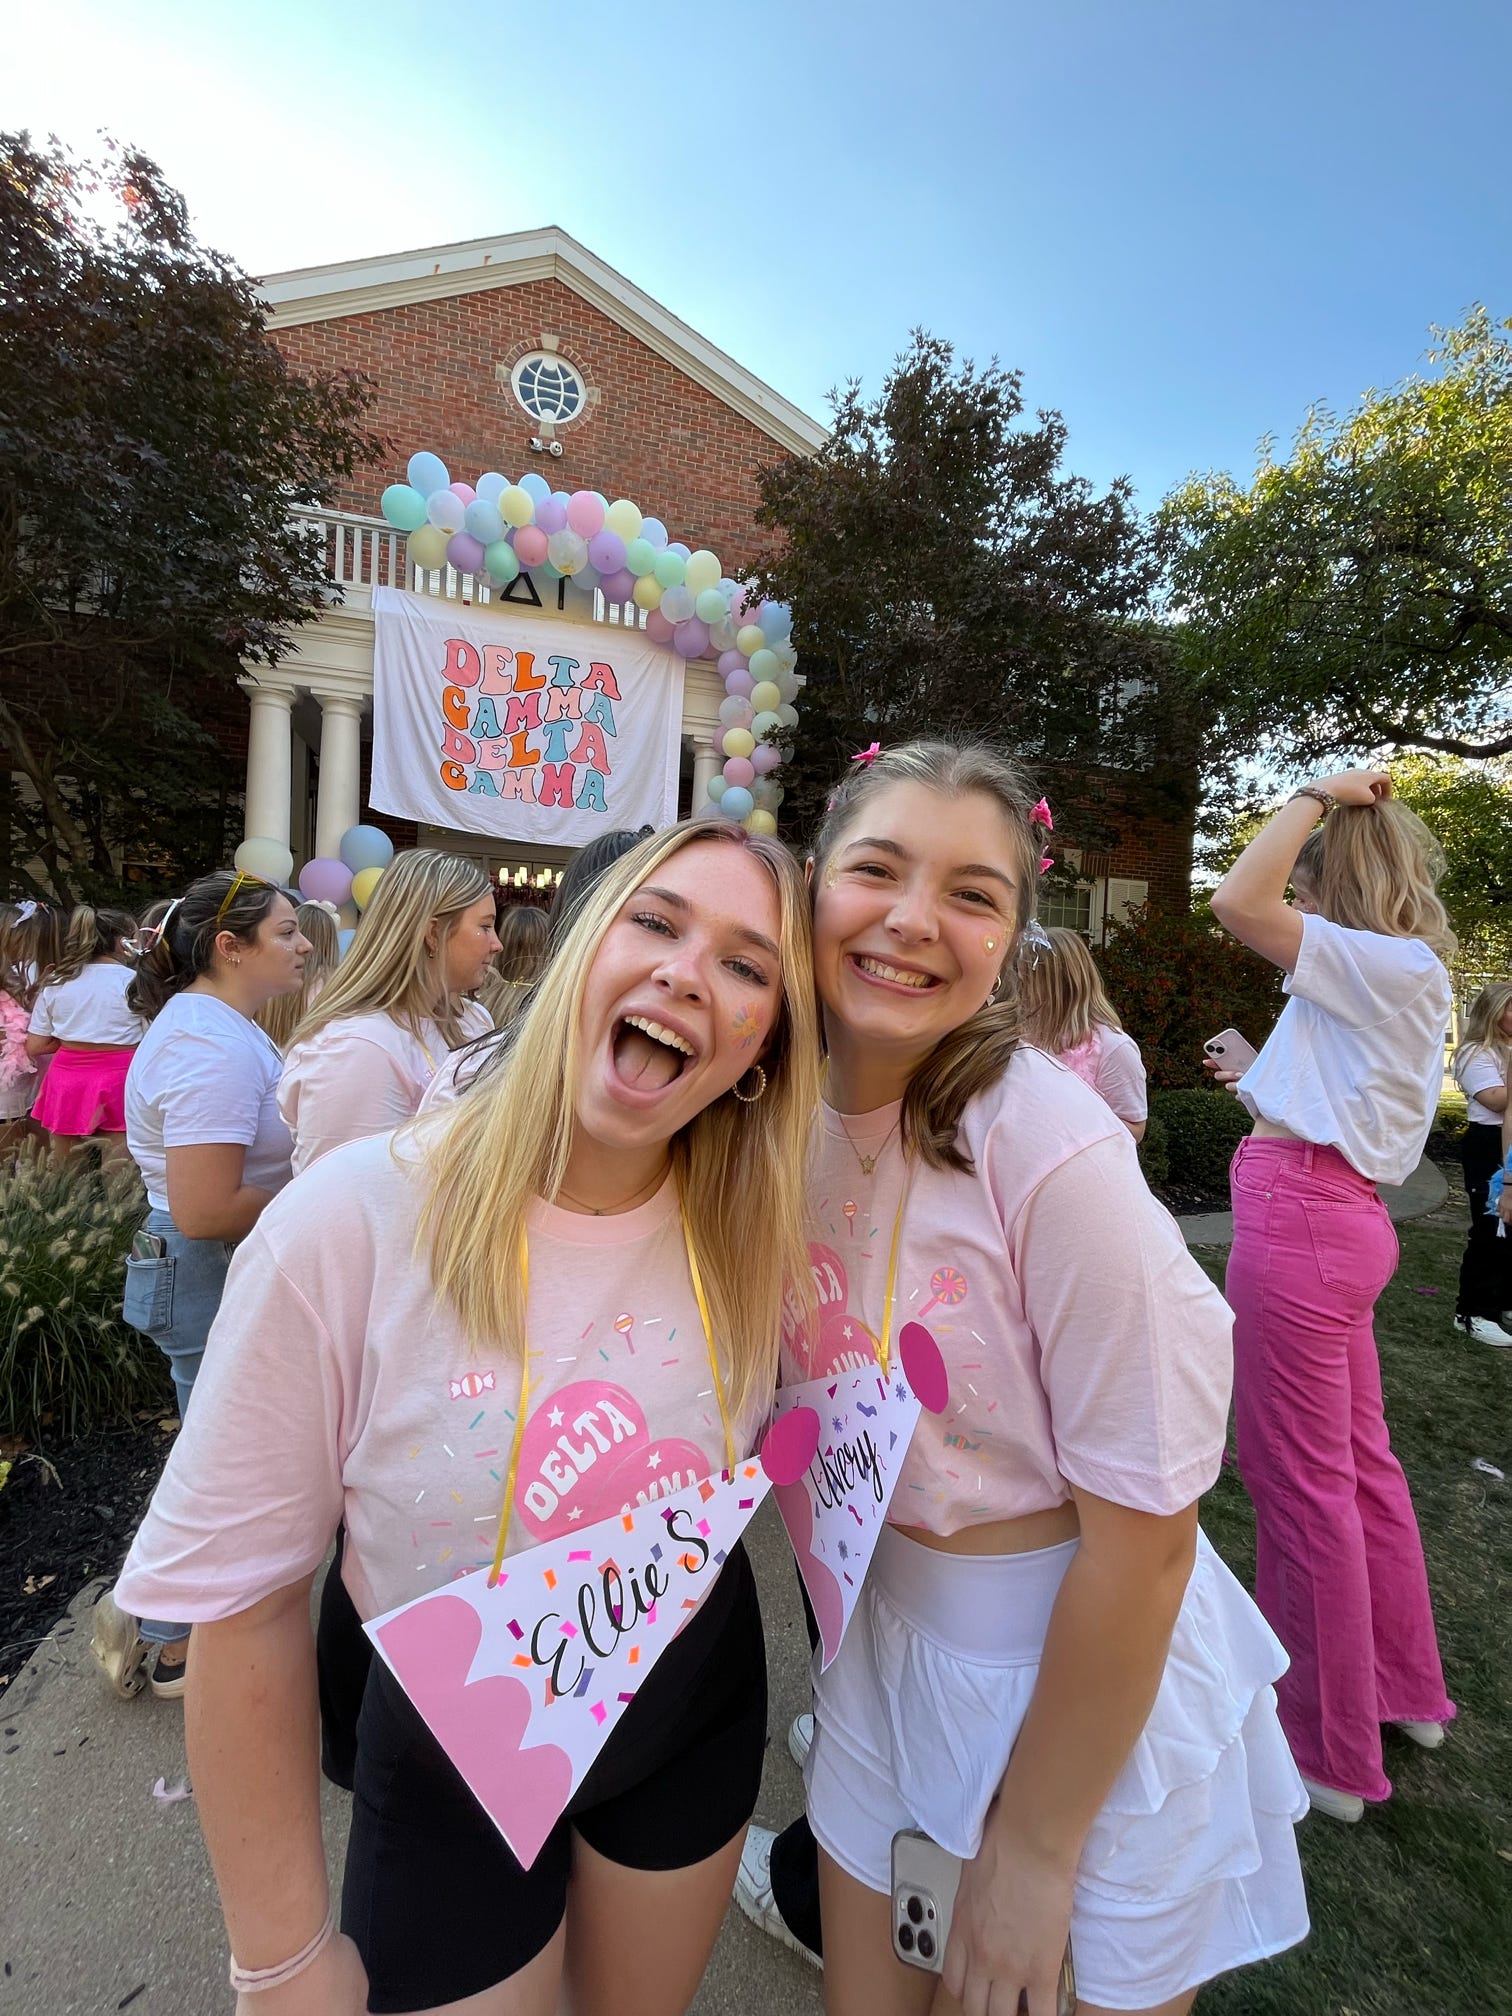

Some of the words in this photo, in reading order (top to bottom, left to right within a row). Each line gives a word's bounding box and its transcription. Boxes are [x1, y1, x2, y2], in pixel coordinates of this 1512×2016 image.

[441, 638, 622, 701] DELTA
[442, 685, 617, 738] GAMMA
[441, 721, 612, 776] DELTA
[440, 760, 608, 812] GAMMA
[524, 1400, 637, 1522] DELTA
[531, 1562, 669, 1697] Ellie
[666, 1509, 710, 1574] S
